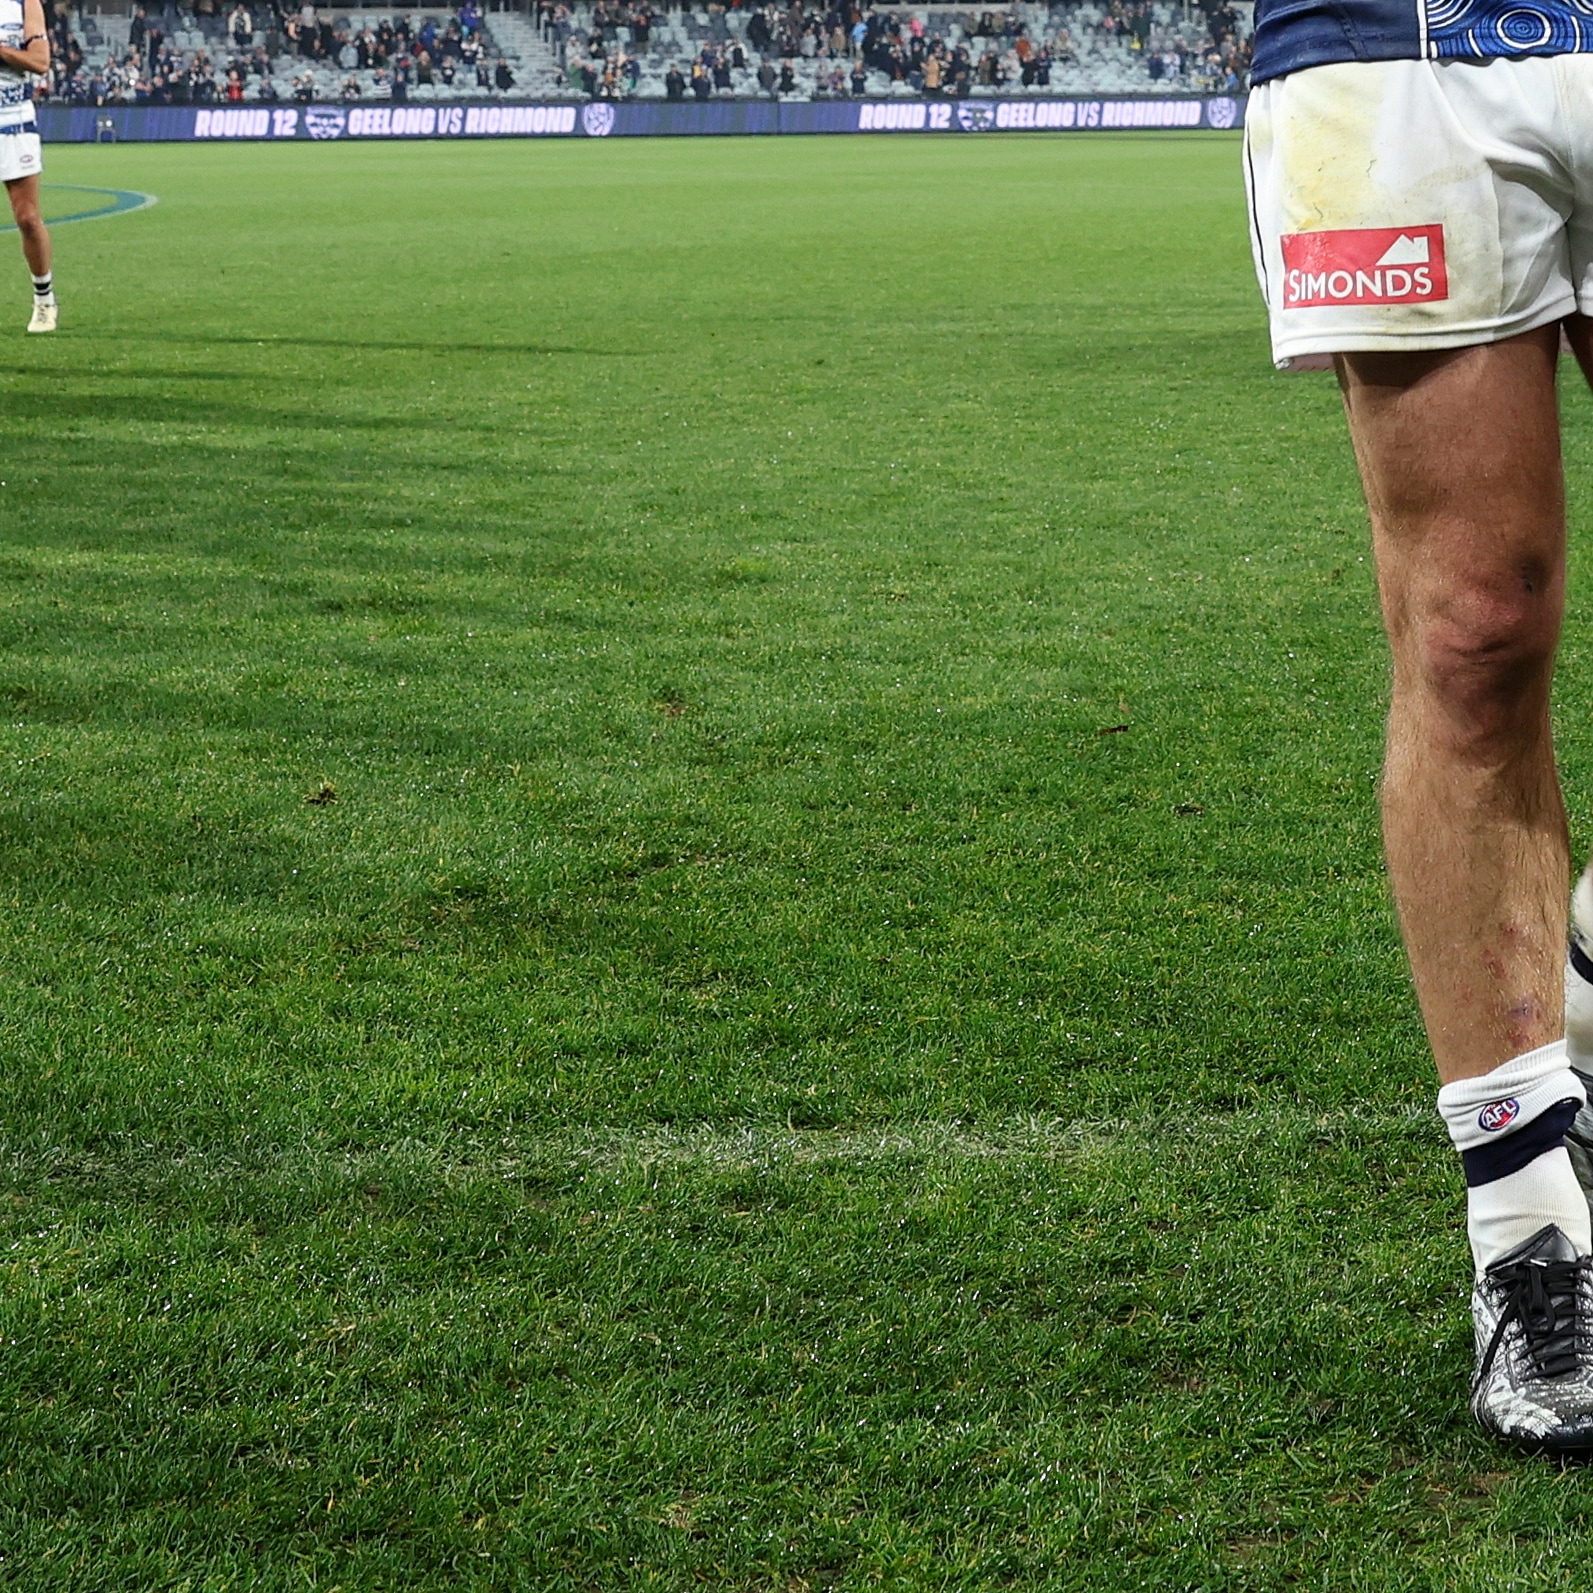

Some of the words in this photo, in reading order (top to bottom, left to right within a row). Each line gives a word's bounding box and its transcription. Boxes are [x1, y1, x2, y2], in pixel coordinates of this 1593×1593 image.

[195, 109, 270, 137] ROUND
[272, 109, 298, 137] 12
[347, 108, 436, 136] GEELONG
[437, 108, 462, 135] VS
[464, 107, 576, 135] RICHMOND
[859, 103, 927, 130] ROUND
[928, 104, 953, 129] 12
[996, 102, 1076, 128] GEELONG
[1076, 102, 1100, 127] VS
[1101, 100, 1202, 127] RICHMOND
[1288, 265, 1434, 303] SIMONDS
[1482, 1098, 1518, 1129] AFL
